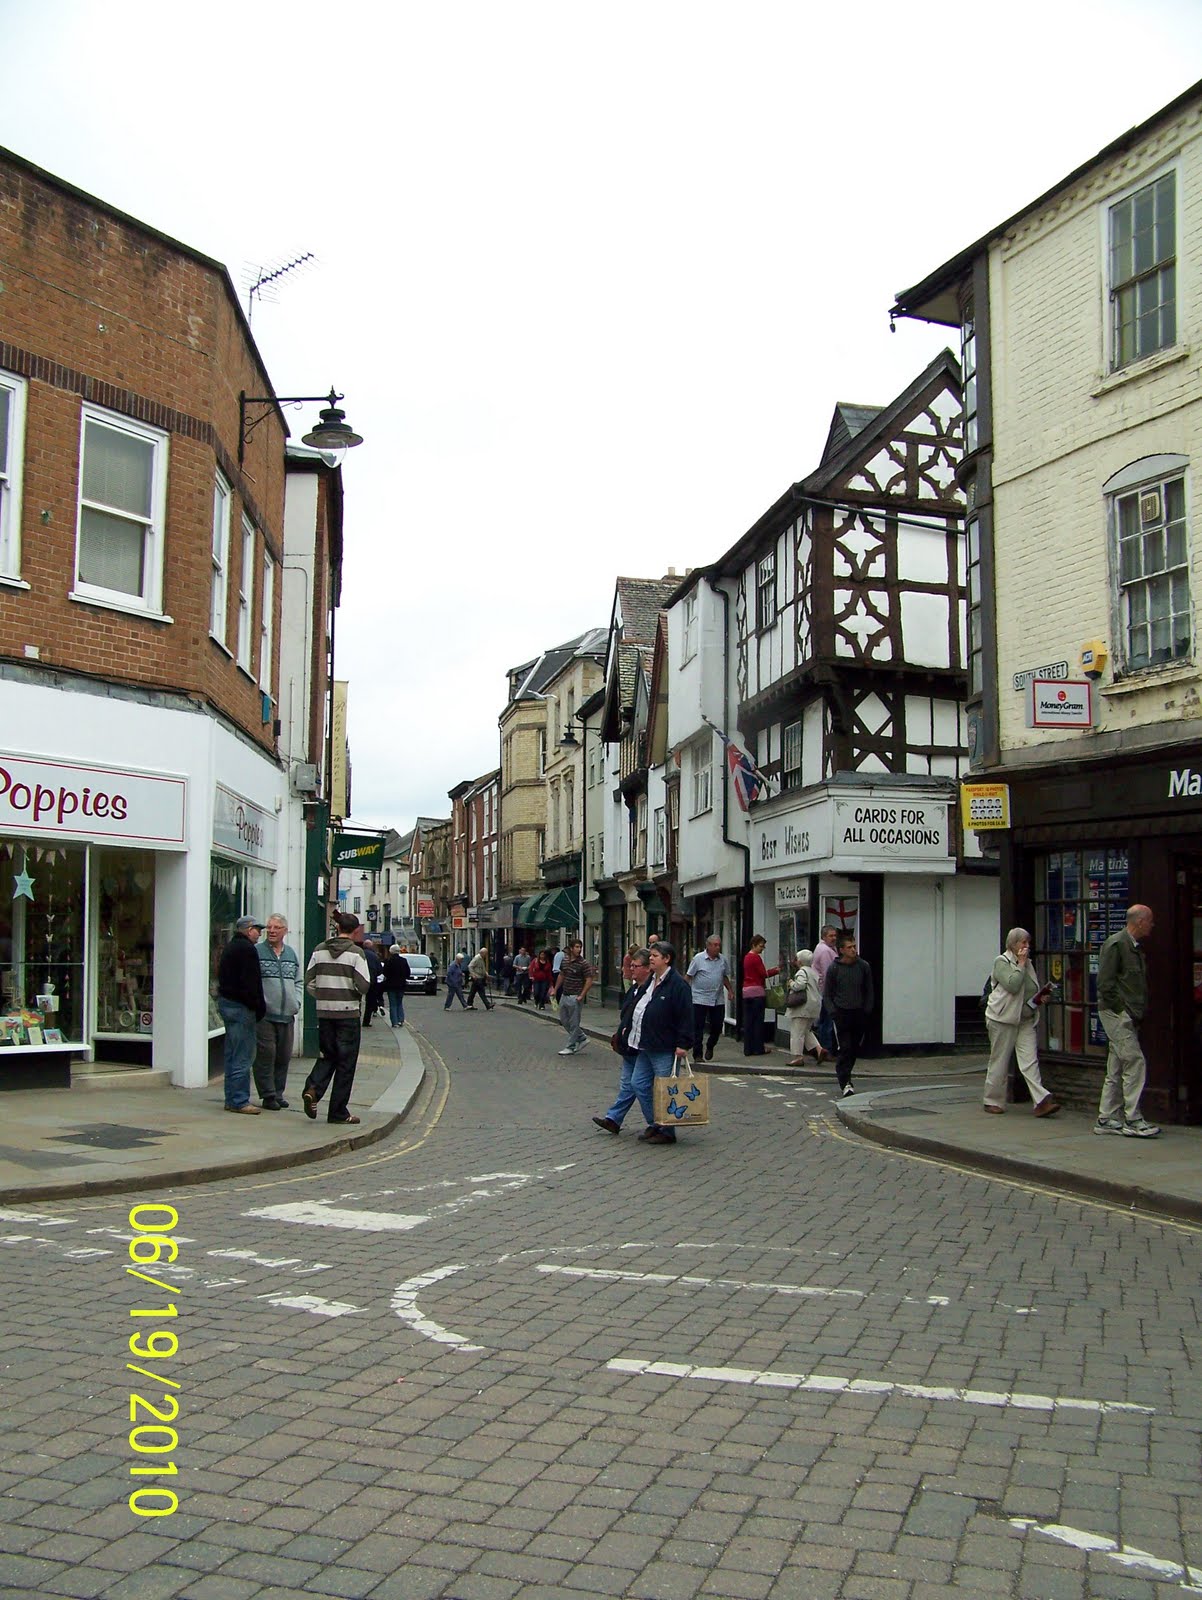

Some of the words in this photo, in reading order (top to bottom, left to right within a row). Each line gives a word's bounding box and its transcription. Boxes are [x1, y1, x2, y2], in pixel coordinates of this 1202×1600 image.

[1039, 663, 1065, 679] STREET
[1040, 701, 1084, 711] MoneyGram
[854, 807, 897, 824] CARDS
[901, 809, 925, 825] FOR
[235, 806, 264, 852] Poppies
[843, 828, 866, 843] ALL
[869, 828, 940, 845] OCCASIONS
[337, 844, 381, 861] SUBWAY
[1089, 857, 1129, 871] Matin's
[777, 887, 785, 899] The
[786, 886, 796, 899] Card
[797, 885, 807, 901] Shop
